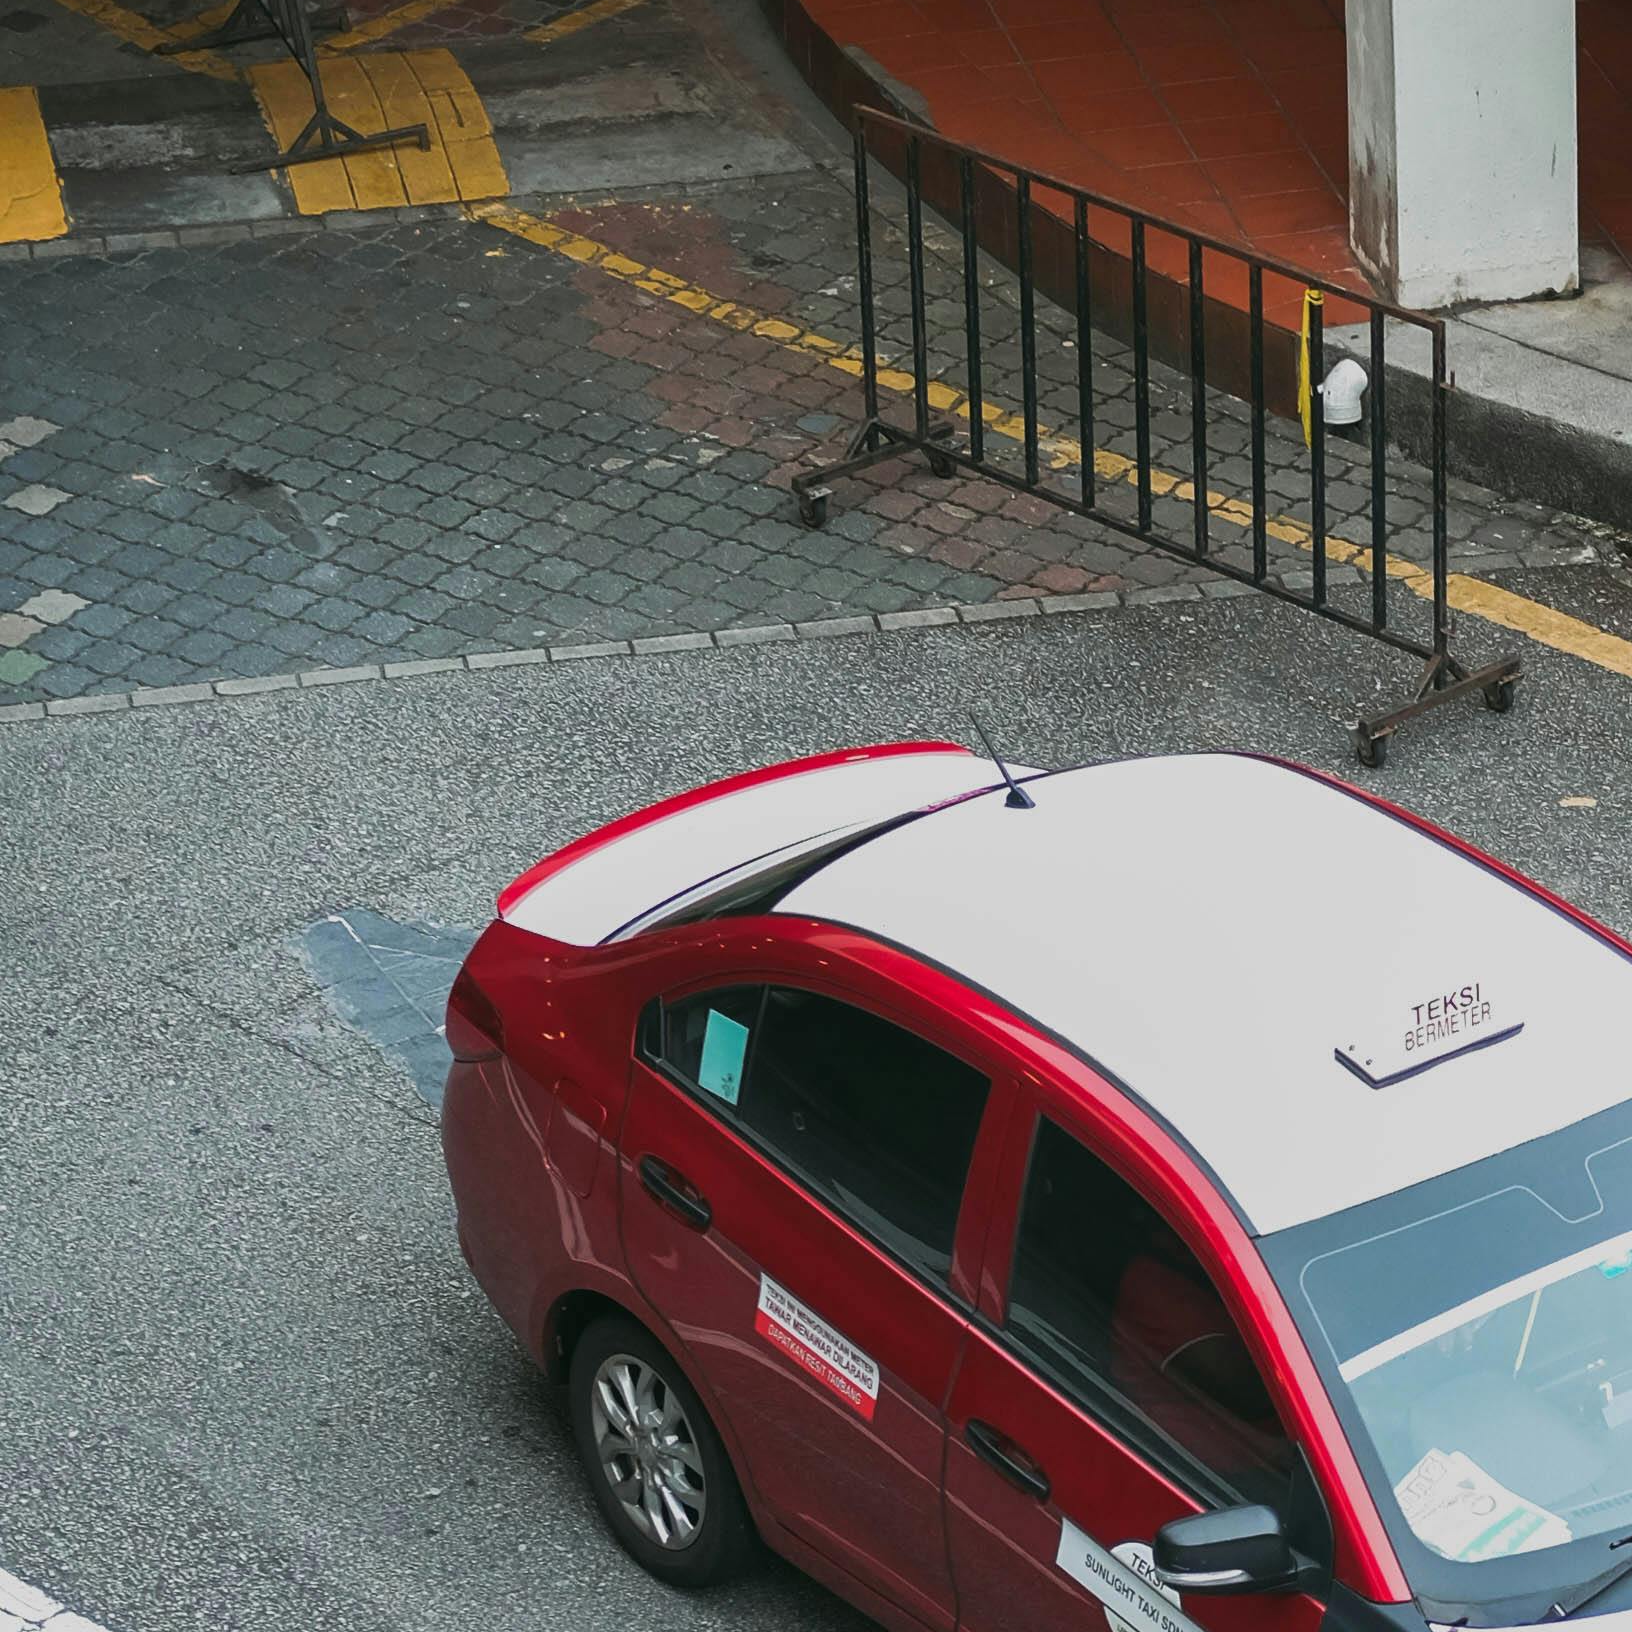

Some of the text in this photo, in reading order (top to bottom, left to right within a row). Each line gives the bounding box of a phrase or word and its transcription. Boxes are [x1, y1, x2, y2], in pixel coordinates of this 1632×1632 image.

[1405, 1001, 1491, 1051] BERMETER
[1411, 982, 1480, 1025] TEKSI
[765, 1296, 874, 1390] TAWAR MENAWAR DILARANG
[768, 1324, 807, 1360] DAPATKAN
[1084, 1553, 1136, 1603] SUNLIGHT
[1137, 1595, 1160, 1623] TAXI
